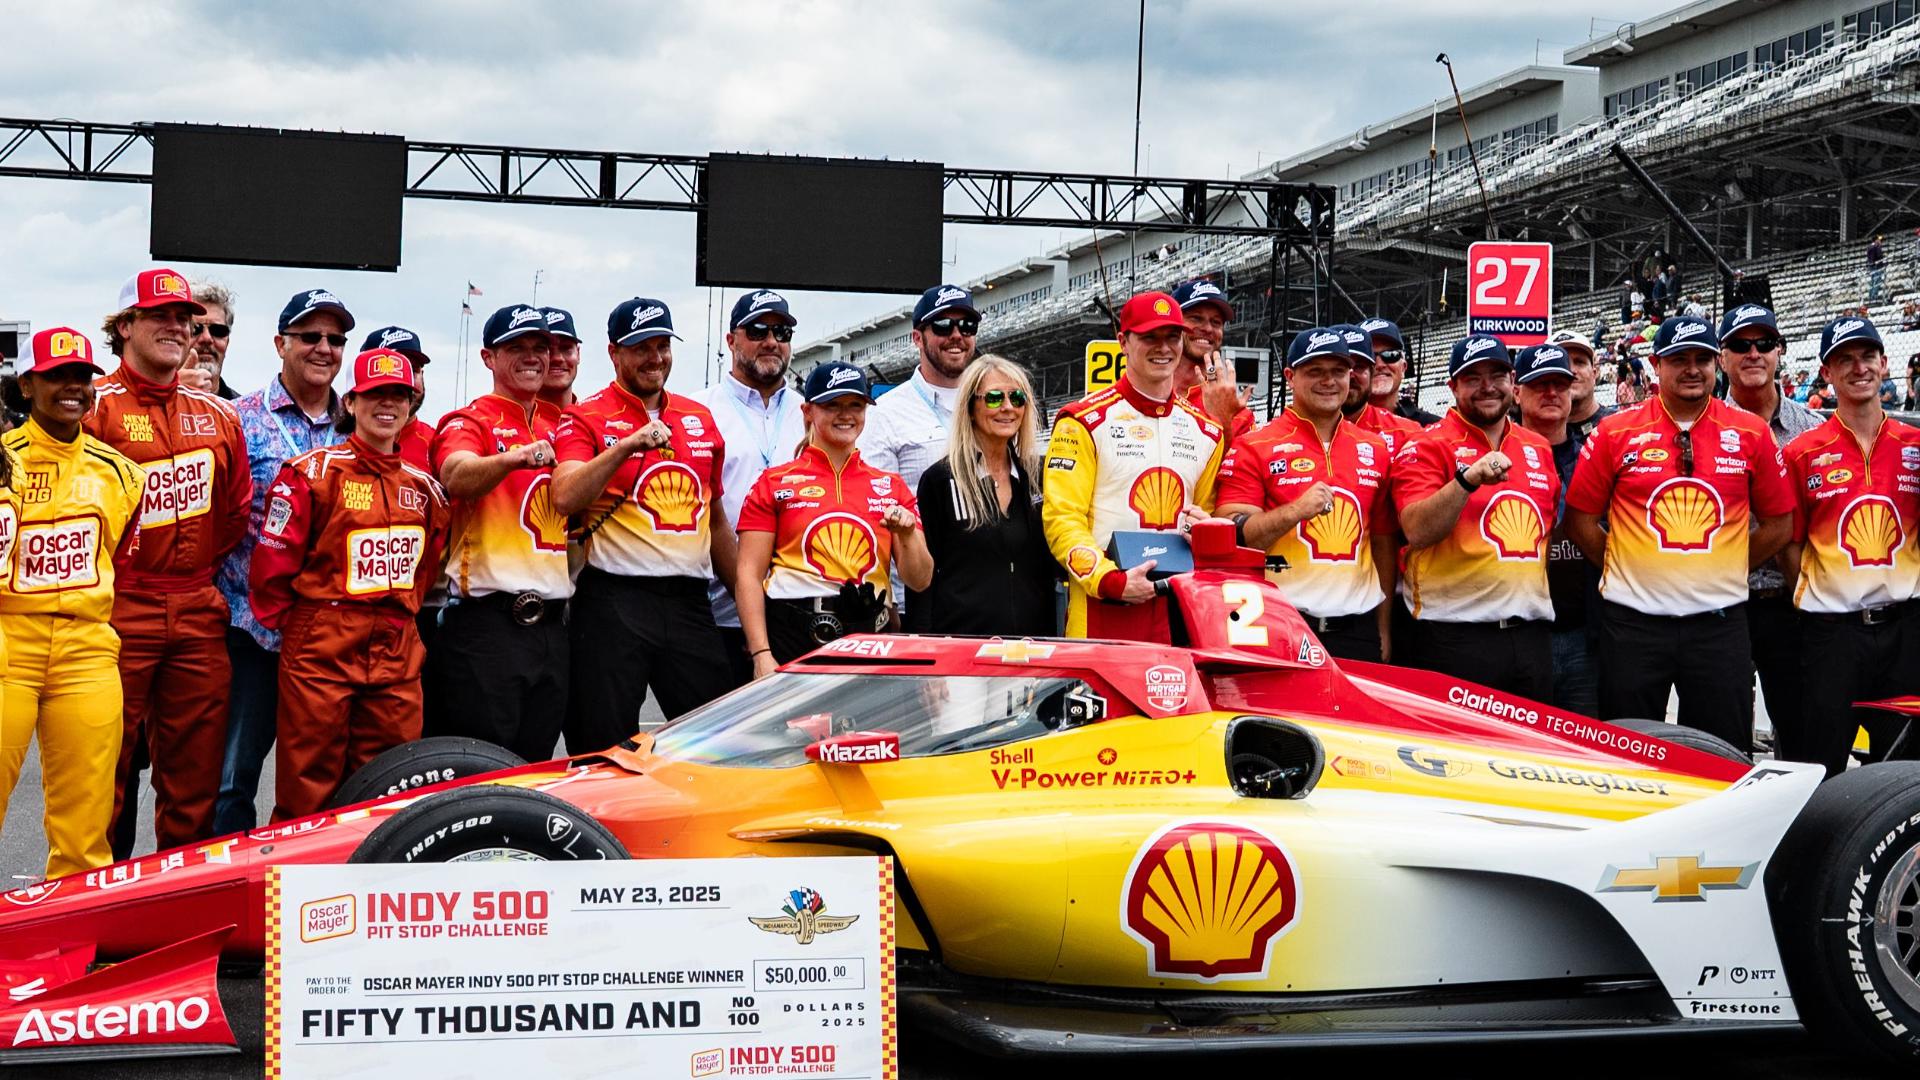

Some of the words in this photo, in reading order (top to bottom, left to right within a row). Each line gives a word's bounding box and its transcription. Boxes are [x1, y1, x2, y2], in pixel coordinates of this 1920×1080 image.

[1475, 256, 1542, 306] 27
[1473, 319, 1545, 332] KIRKWOOD
[122, 414, 150, 424] NEW
[122, 423, 154, 433] YORK
[180, 412, 217, 436] 02
[129, 432, 154, 442] DOG
[1714, 456, 1747, 467] verizon
[26, 472, 50, 489] HI
[147, 461, 206, 491] Oscar
[342, 488, 374, 502] YORK
[344, 479, 373, 493] NEW
[1897, 483, 1920, 493] Astem
[23, 487, 52, 504] OG
[144, 481, 208, 515] Mayer
[345, 499, 371, 511] DOG
[28, 530, 91, 556] Oscar
[359, 533, 419, 558] Oscar
[25, 552, 90, 580] Mayer
[357, 556, 415, 581] Mayer
[1221, 582, 1269, 647] 2
[1147, 684, 1186, 693] INDYCAR
[1448, 686, 1539, 725] Clarience
[1545, 714, 1667, 762] TECHNOLOGIES
[820, 741, 897, 762] Mazak
[990, 747, 1034, 765] Shell
[990, 767, 1108, 789] V-Power
[1487, 759, 1670, 796] Gallagher
[405, 826, 448, 862] INDY
[451, 814, 493, 833] 500
[1869, 823, 1908, 865] INDY
[580, 887, 625, 904] MAY
[631, 886, 663, 905] 23,
[669, 885, 721, 902] 2025
[309, 903, 348, 921] Oscar
[367, 891, 461, 923] INDY
[473, 890, 549, 920] 500
[308, 915, 349, 933] Mayer
[367, 925, 394, 939] PIT
[398, 924, 443, 938] STOP
[447, 922, 549, 938] CHALLENGE
[1846, 865, 1908, 1037] FIREHAWK
[306, 977, 322, 986] PAY
[324, 977, 335, 985] TO
[337, 976, 352, 985] THE
[363, 976, 412, 991] OSCAR
[415, 976, 465, 990] MAYER
[468, 975, 503, 988] INDY
[506, 974, 535, 987] 500
[538, 973, 558, 987] PIT
[563, 972, 600, 987] STOP
[603, 971, 684, 985] CHALLENGE
[688, 969, 744, 983] WINNER
[1751, 969, 1777, 980] NTT
[308, 986, 335, 995] ORDER
[338, 985, 350, 994] OF:
[732, 996, 755, 1008] NO
[783, 1002, 866, 1013] DOLLARS
[1690, 1000, 1781, 1015] Firestone
[12, 996, 210, 1047] Astemo
[302, 1007, 404, 1038] FIFTY
[415, 1001, 615, 1035] THOUSAND
[625, 1000, 701, 1030] AND
[727, 1012, 760, 1026] 100
[821, 1018, 866, 1027] 2025
[695, 1052, 719, 1063] Oscar
[729, 1045, 785, 1066] INDY
[790, 1044, 836, 1063] 500
[695, 1060, 720, 1073] Mayer
[729, 1065, 747, 1075] PIT
[748, 1065, 775, 1074] STOP
[776, 1062, 836, 1074] CHALLENGE
